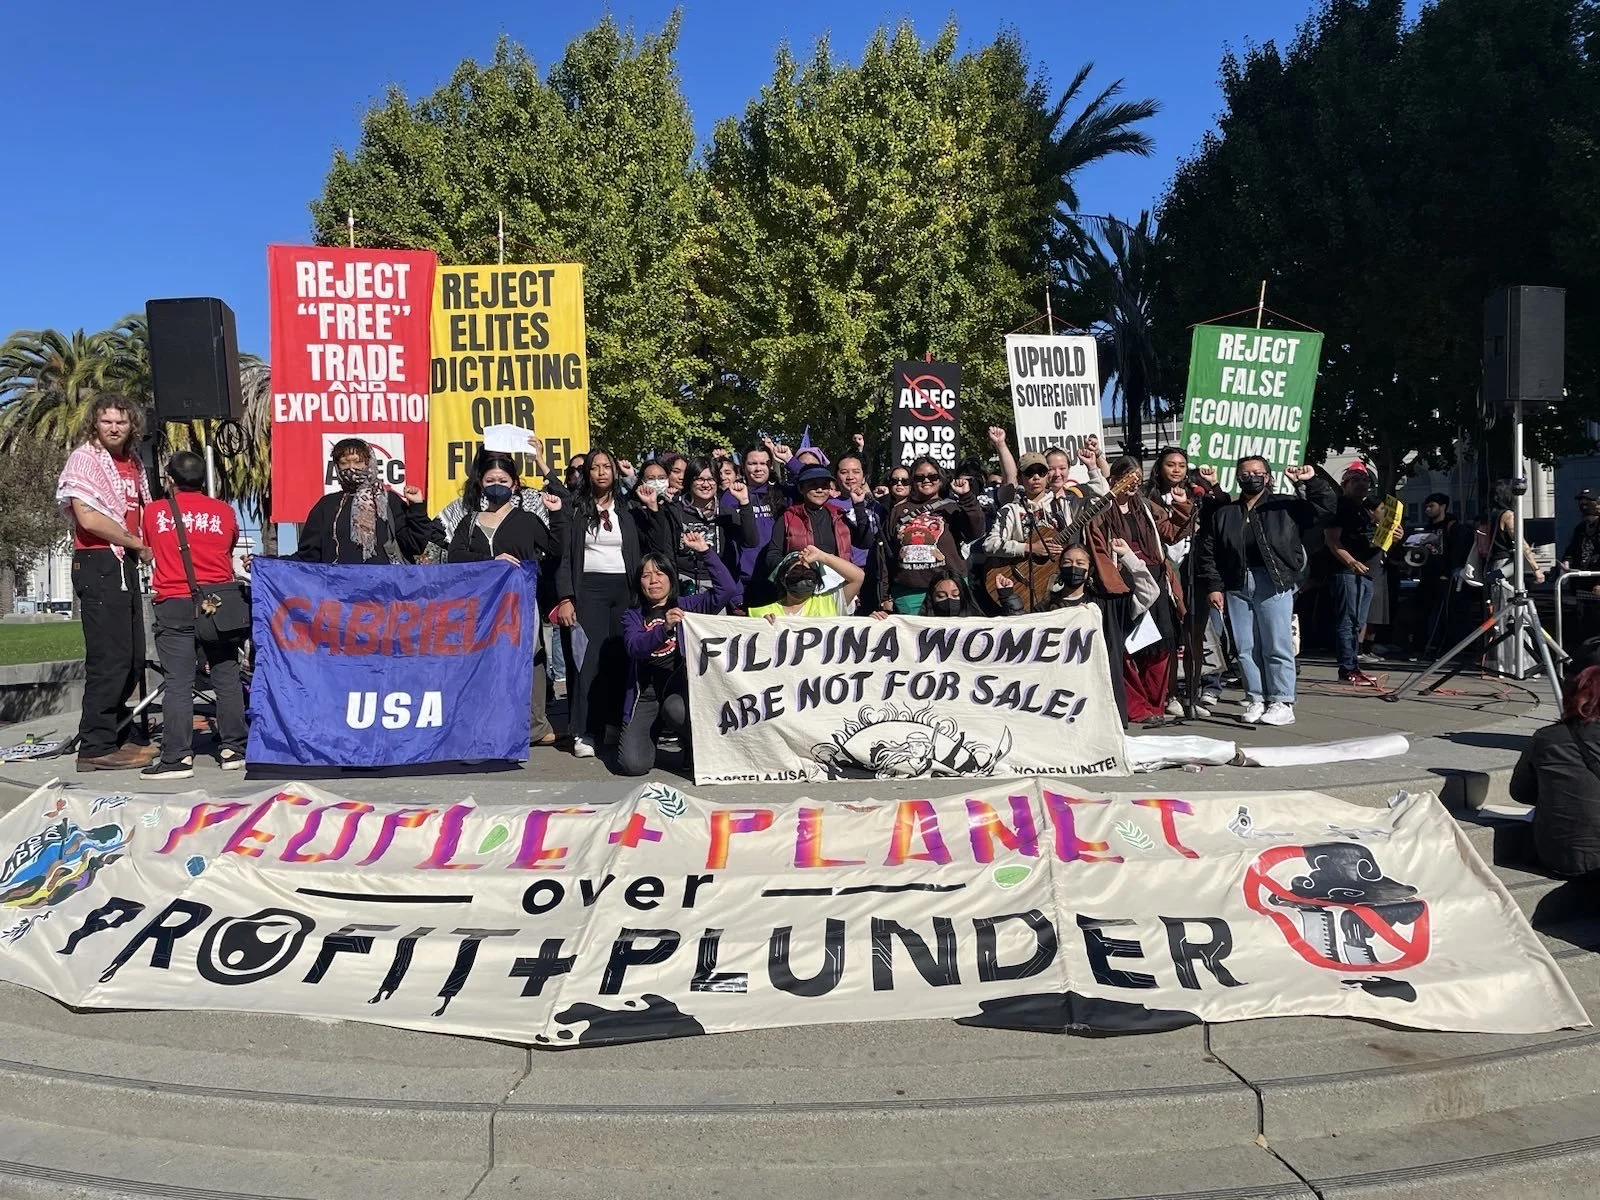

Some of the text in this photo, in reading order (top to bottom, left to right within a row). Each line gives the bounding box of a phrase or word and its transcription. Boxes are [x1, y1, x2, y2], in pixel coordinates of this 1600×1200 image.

[295, 261, 411, 299] REJECT
[442, 269, 555, 310] REJECT
[450, 312, 550, 352] ELITES
[1217, 333, 1300, 365] REJECT
[306, 344, 406, 382] TRADE
[431, 353, 583, 394] DICTATING
[1014, 346, 1086, 378] UPHOLD
[328, 381, 387, 393] AND
[899, 388, 956, 409] APEC
[1016, 383, 1096, 407] SOVEREIGNTY
[1220, 366, 1287, 398] FALSE
[274, 393, 430, 423] EXPLOITATIO
[471, 395, 535, 435] OUR
[1054, 410, 1068, 430] OF
[1188, 397, 1302, 433] ECONOMIC
[900, 425, 955, 442] NO TO
[901, 442, 956, 460] APEC
[1024, 434, 1097, 466] NAON
[1186, 432, 1302, 466] & CLIMATE
[325, 459, 405, 485] AC
[448, 438, 571, 480] FUE!
[271, 592, 521, 657] GABRIELA
[700, 626, 1098, 676] FILIPINA WOMEN
[345, 691, 443, 729] USA
[719, 669, 1088, 735] ARE NOT FOR SALE!
[1070, 756, 1118, 775] UNITE!
[156, 792, 597, 870] PEOPLE
[706, 789, 1200, 869] PLANET
[522, 873, 714, 914] over
[598, 908, 1248, 997] PLUNDER
